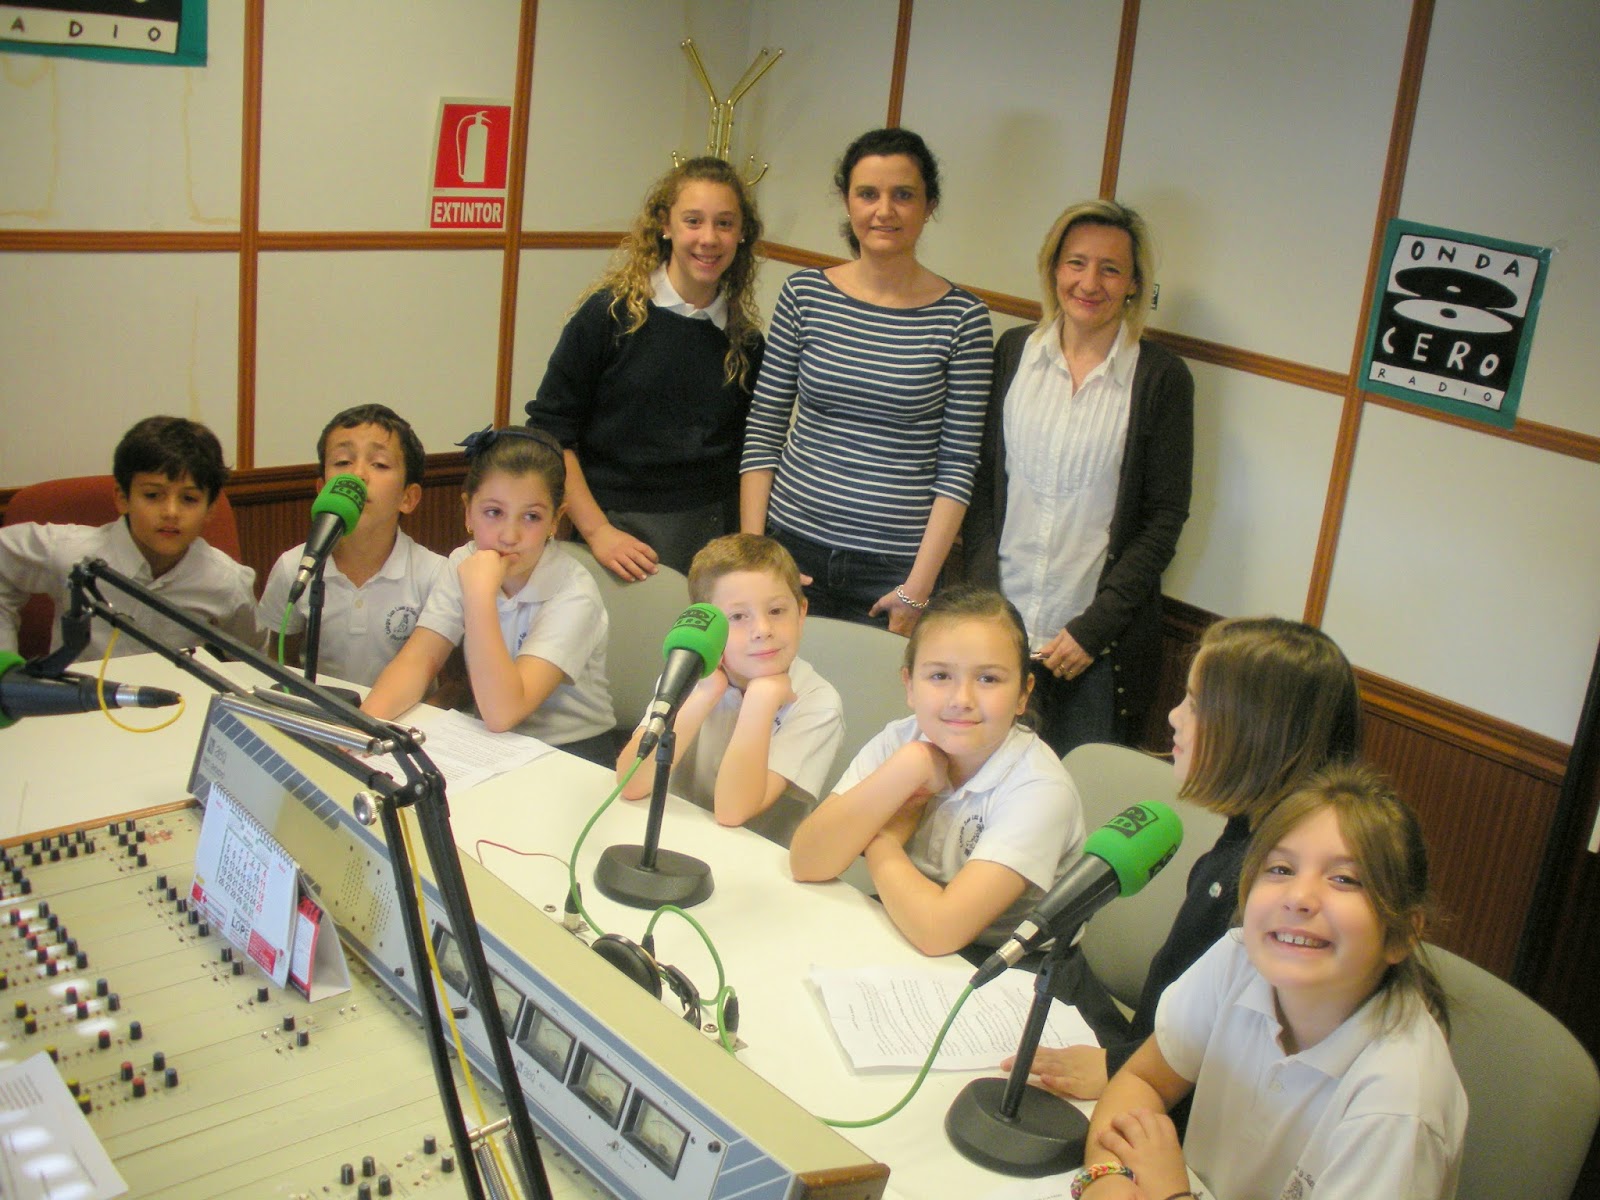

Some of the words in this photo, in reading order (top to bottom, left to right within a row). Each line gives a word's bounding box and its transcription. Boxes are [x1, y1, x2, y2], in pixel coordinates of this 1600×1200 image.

[433, 202, 502, 223] EXTINTOR
[1410, 240, 1520, 277] ONDA
[1381, 326, 1500, 377] CERO
[1377, 367, 1492, 402] RADIO
